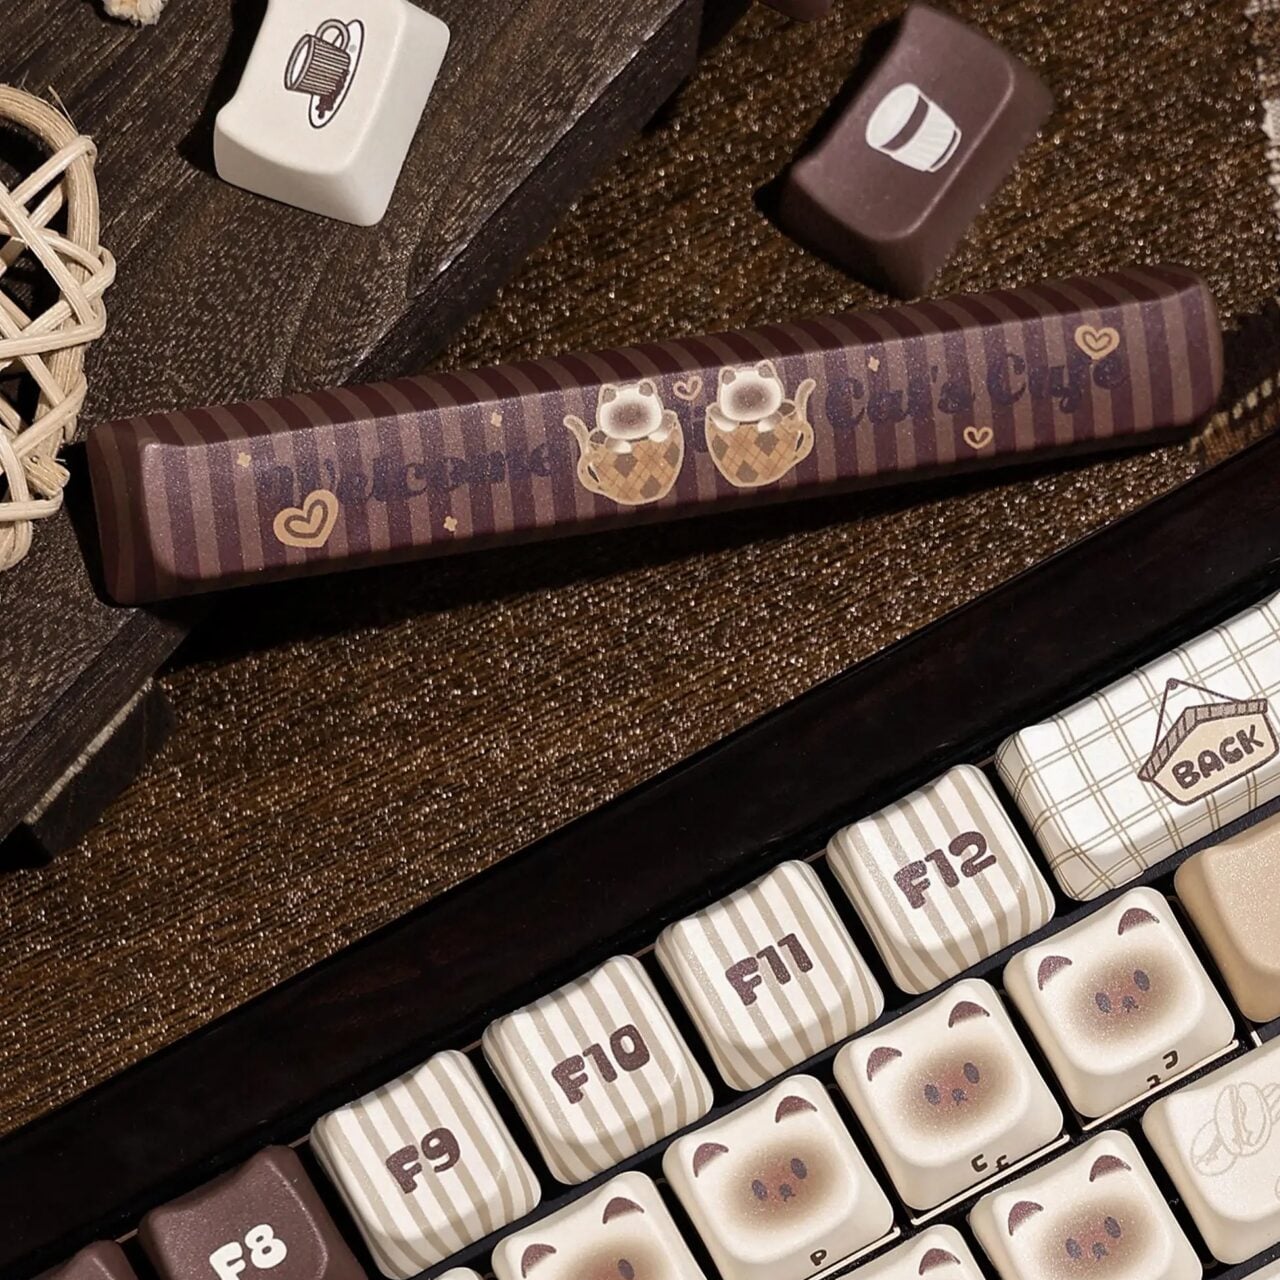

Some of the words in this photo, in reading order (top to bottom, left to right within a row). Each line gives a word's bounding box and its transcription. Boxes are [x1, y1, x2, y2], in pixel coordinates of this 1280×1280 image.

[1171, 724, 1265, 790] BACK
[893, 831, 997, 909] F12
[725, 933, 813, 1006] F11
[551, 1024, 650, 1104] F10
[385, 1127, 461, 1194] F9
[809, 1249, 827, 1267] P
